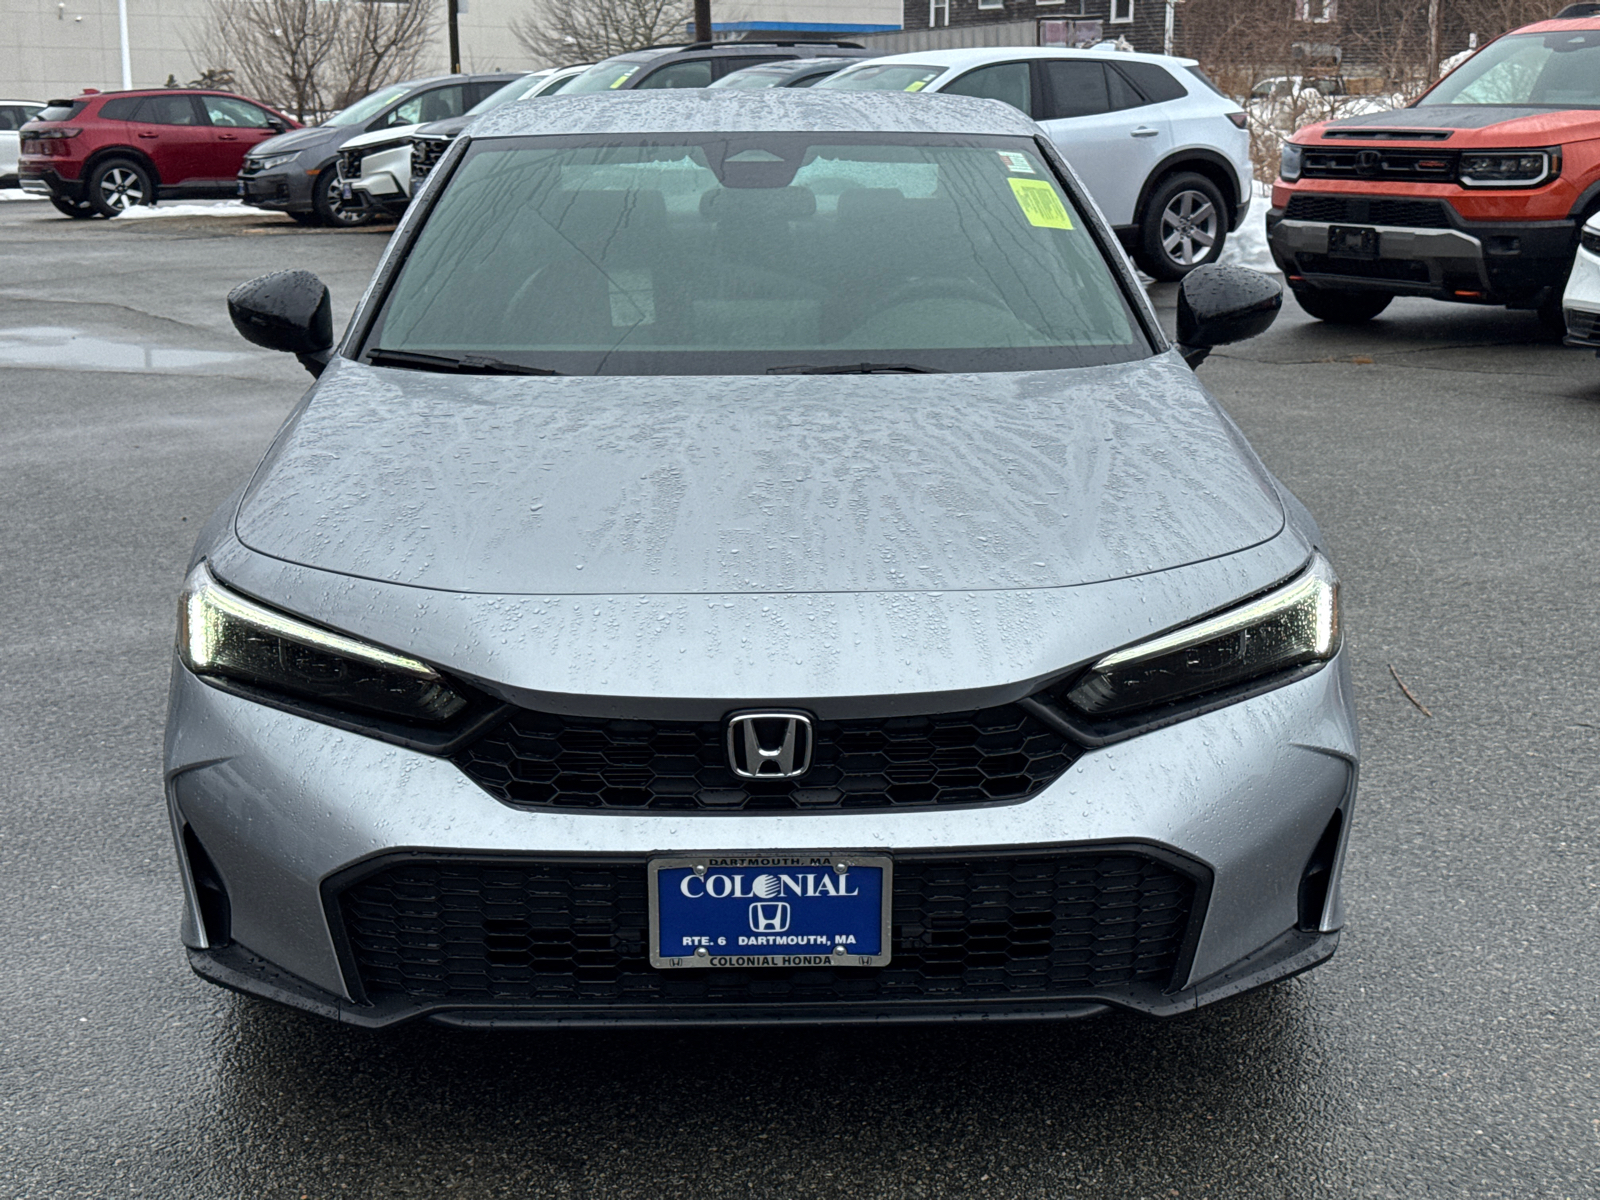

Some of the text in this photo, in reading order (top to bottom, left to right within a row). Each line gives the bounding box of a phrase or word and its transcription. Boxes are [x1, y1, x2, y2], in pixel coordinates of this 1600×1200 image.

[680, 873, 859, 899] COLONIAL
[682, 935, 856, 946] RTE. 6 DARTMOUTH, MA
[709, 956, 832, 967] COLONIAL HONDA
